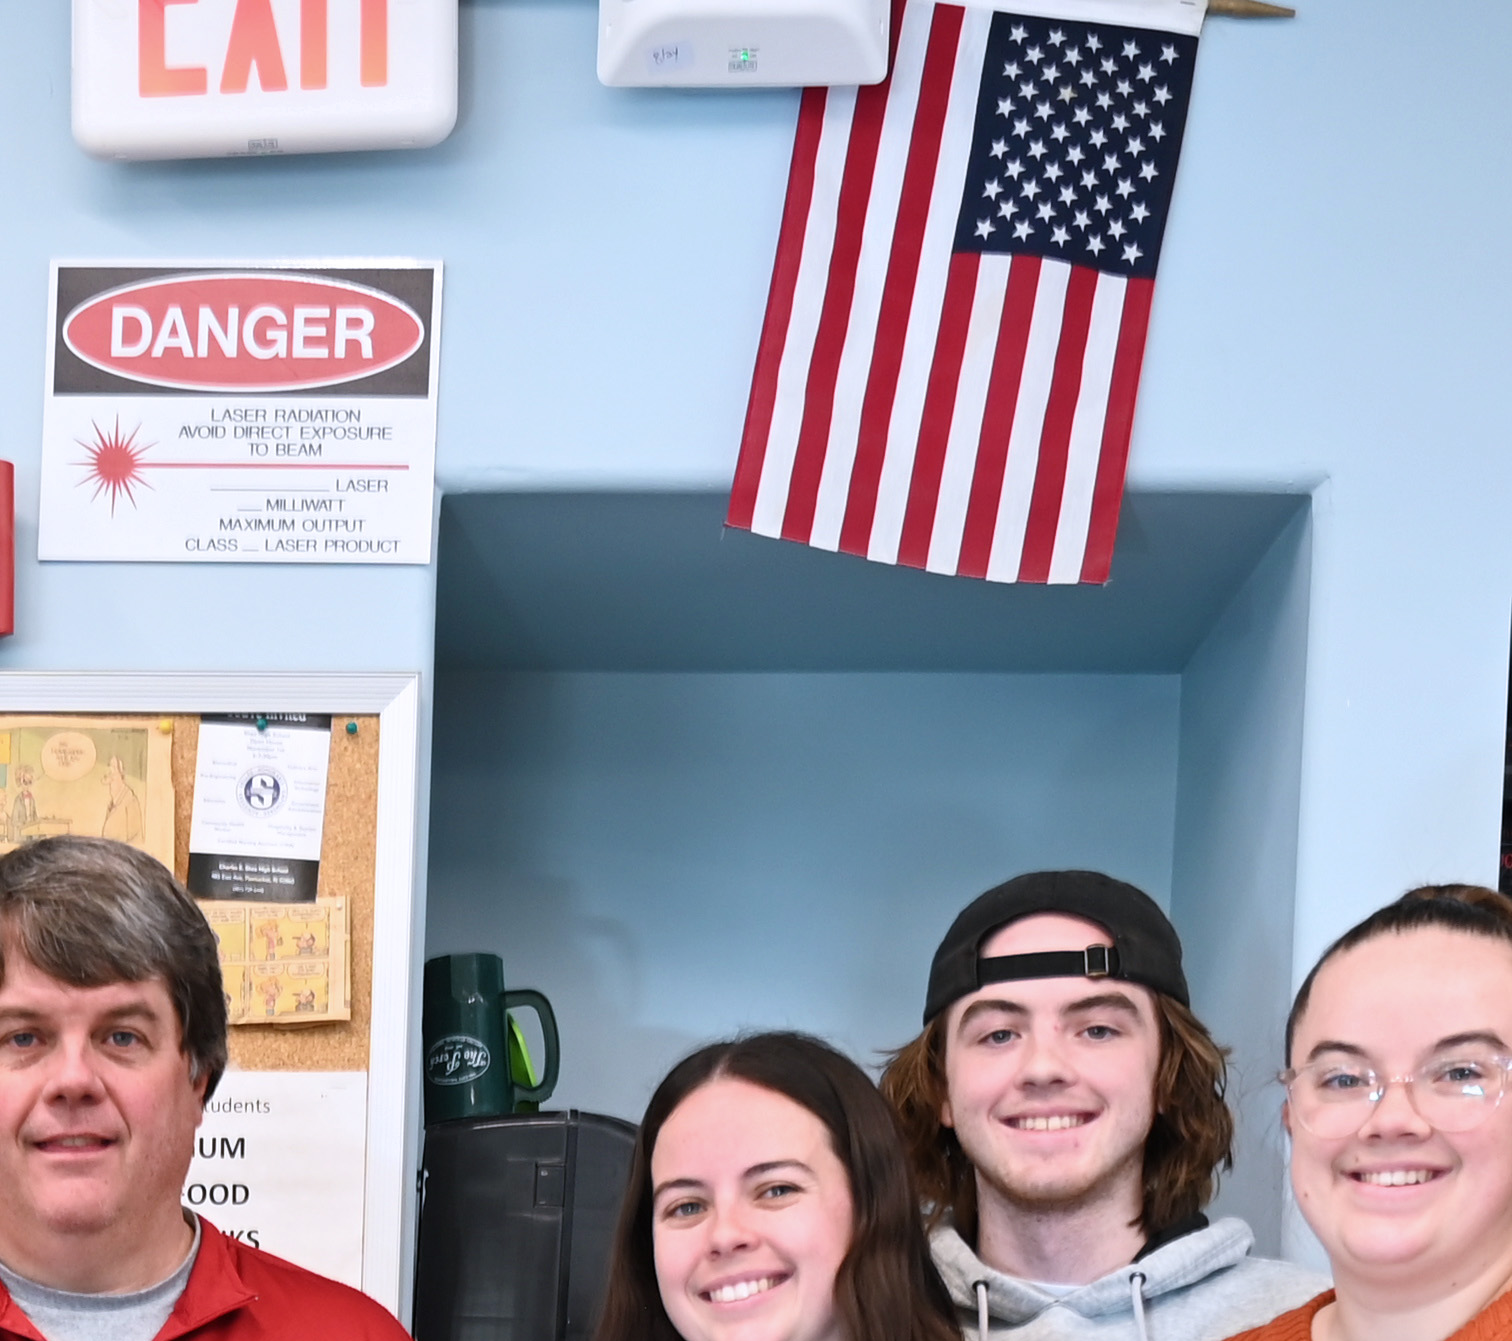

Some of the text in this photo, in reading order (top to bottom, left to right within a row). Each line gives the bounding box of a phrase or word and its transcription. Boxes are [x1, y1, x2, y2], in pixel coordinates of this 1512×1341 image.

[109, 303, 375, 360] DANGER
[210, 408, 361, 423] LASER RADIATION
[178, 425, 392, 441] AVOID DIRECT EXPOSURE
[249, 442, 322, 457] TO BEAM
[335, 479, 388, 493] LASER
[266, 498, 345, 513] MILLIWATT
[219, 518, 366, 533] MAXIMUM OUTPUT
[185, 538, 401, 554] CLASS LASER PRODUCT
[203, 1097, 271, 1113] tudents
[192, 1137, 246, 1159] UM
[182, 1183, 250, 1206] OOD
